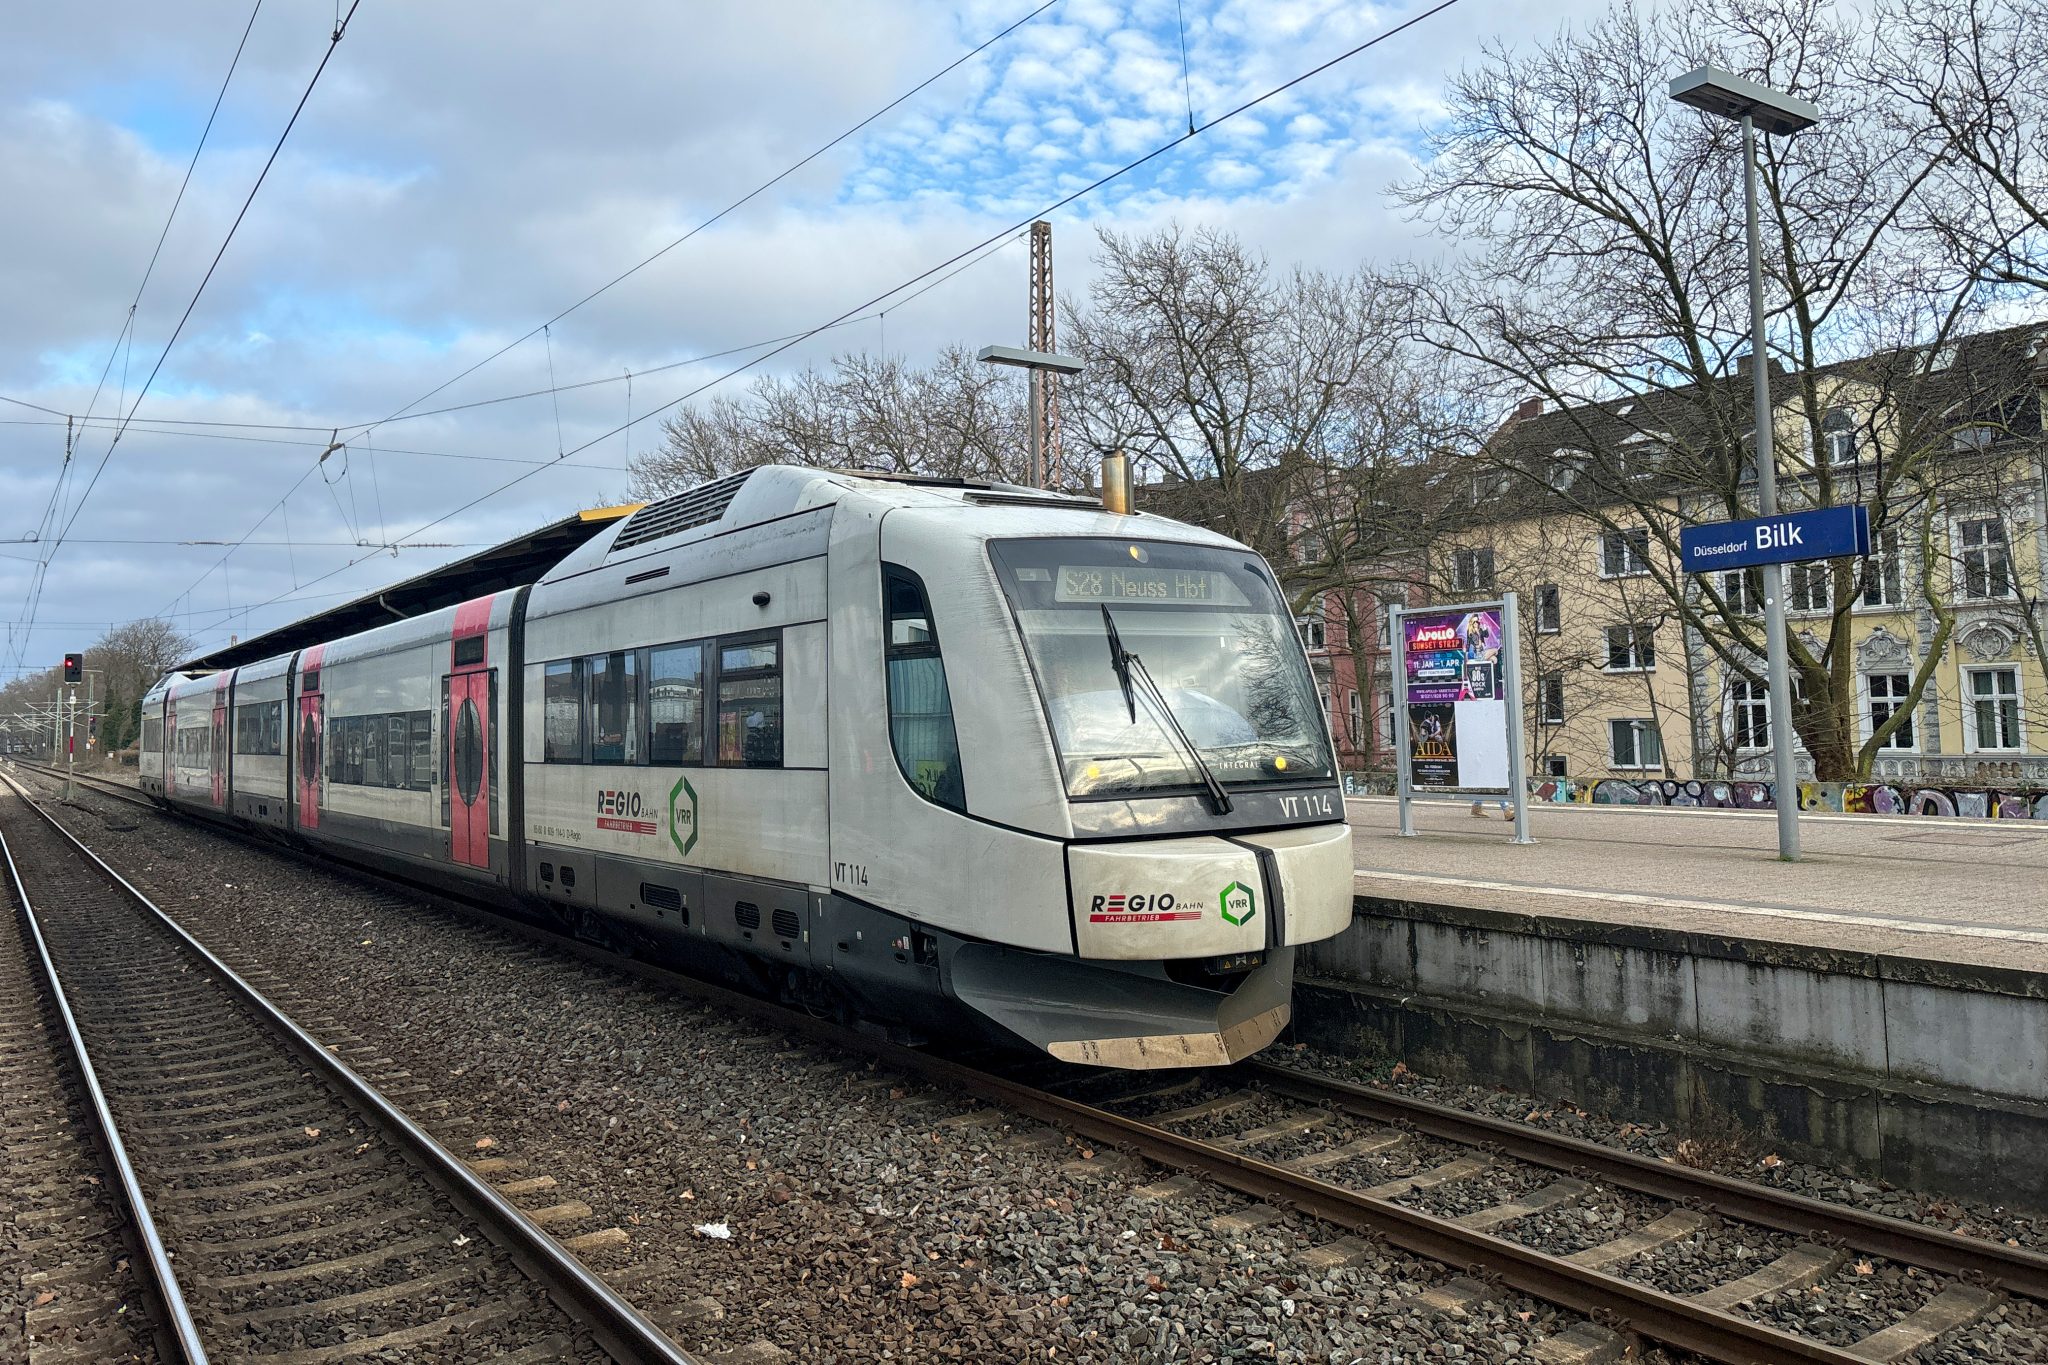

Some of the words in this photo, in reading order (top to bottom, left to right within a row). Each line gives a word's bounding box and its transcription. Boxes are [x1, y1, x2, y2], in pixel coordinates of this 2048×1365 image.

[1694, 541, 1748, 557] Düsseldorf
[1755, 522, 1803, 549] Bilk
[1065, 571, 1103, 596] S28
[1111, 571, 1167, 598] Neuss
[1416, 627, 1455, 641] APOLLO
[1412, 641, 1437, 650] SUNSET
[1438, 640, 1460, 649] STRIP
[1421, 660, 1434, 668] JAN
[1446, 659, 1460, 667] APR
[1414, 741, 1453, 756] AIDA
[1219, 761, 1259, 770] INTEGRAL
[1279, 796, 1299, 818] VT
[1303, 794, 1333, 817] 114
[675, 808, 692, 825] VRR
[834, 861, 847, 883] VT
[849, 864, 869, 886] 114
[1175, 901, 1204, 911] BAHN
[1228, 898, 1248, 909] VRR
[1104, 914, 1160, 922] FAHRBETRIEB
